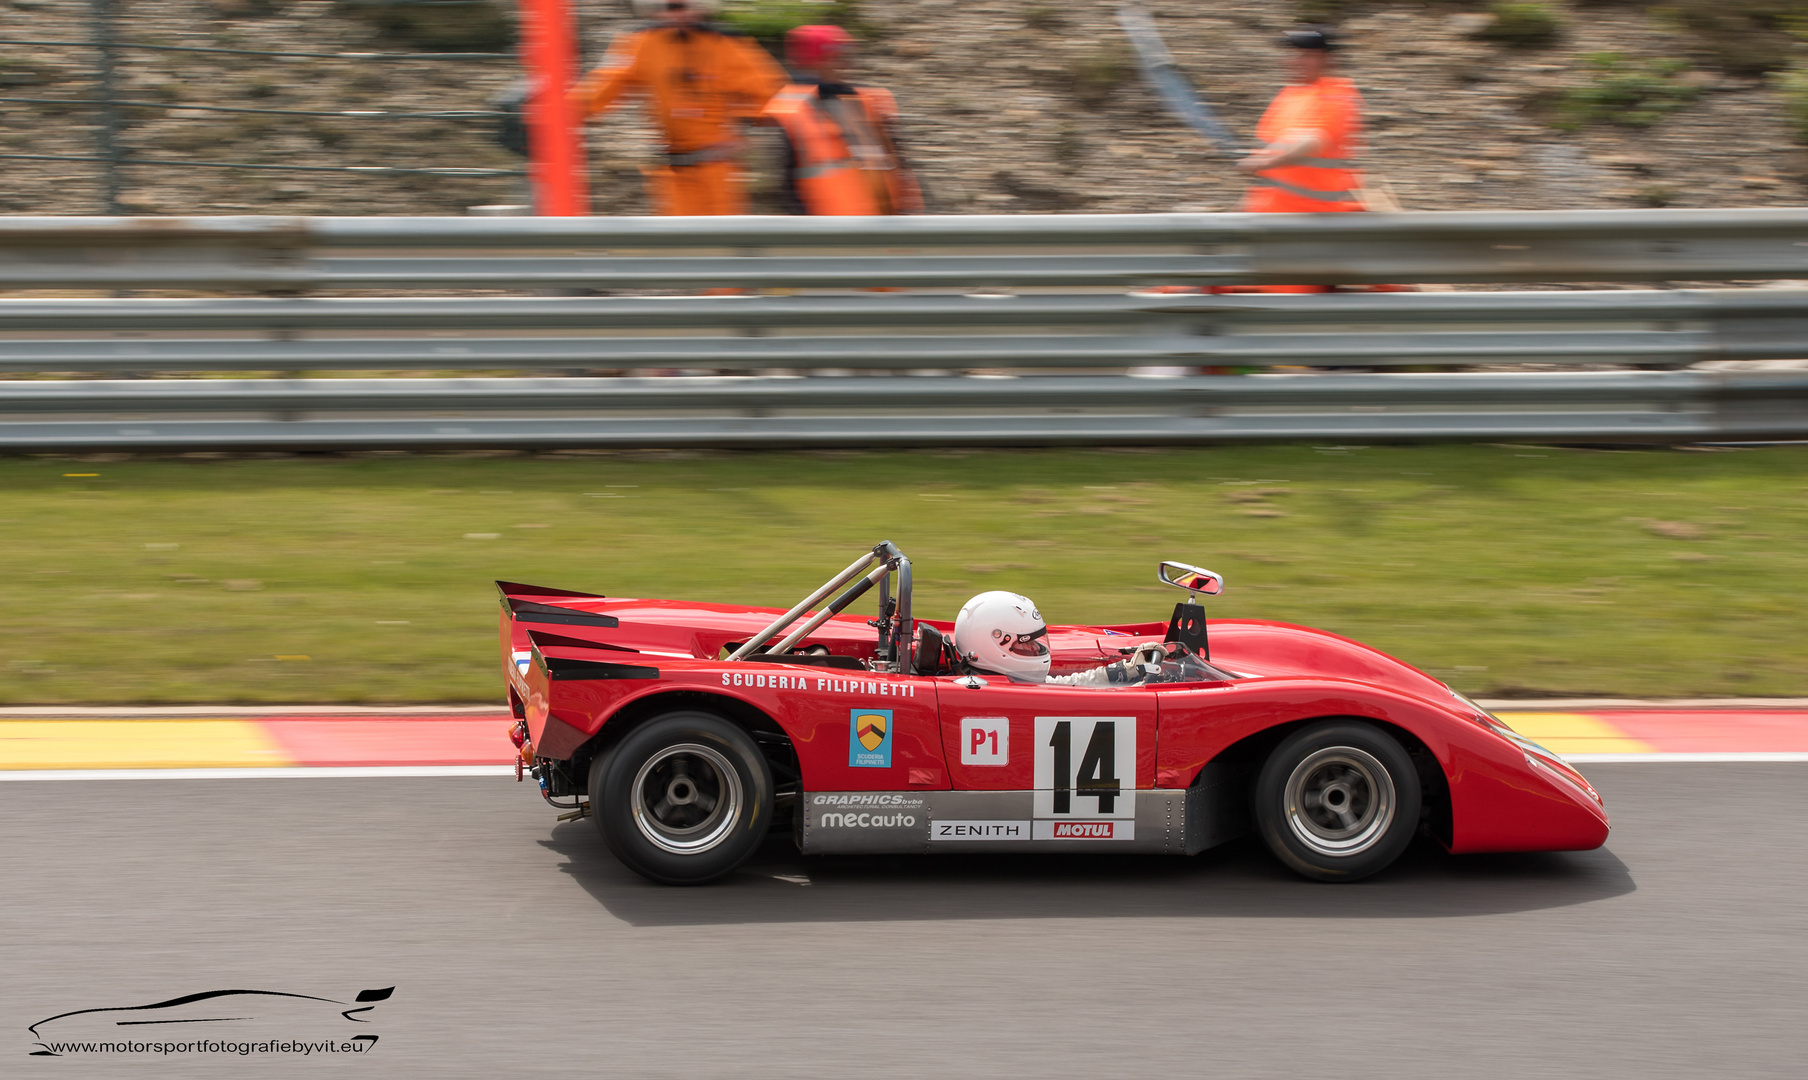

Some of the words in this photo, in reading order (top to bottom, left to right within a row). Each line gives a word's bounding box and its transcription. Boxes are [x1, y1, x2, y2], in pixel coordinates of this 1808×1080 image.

[721, 672, 808, 691] SCUDERIA
[817, 678, 915, 698] FILIPINETTI
[970, 728, 998, 756] P1
[1048, 721, 1121, 814] 14
[813, 795, 904, 805] GRAPHICS
[939, 825, 1020, 836] ZENITH
[1056, 824, 1111, 837] MOTUL
